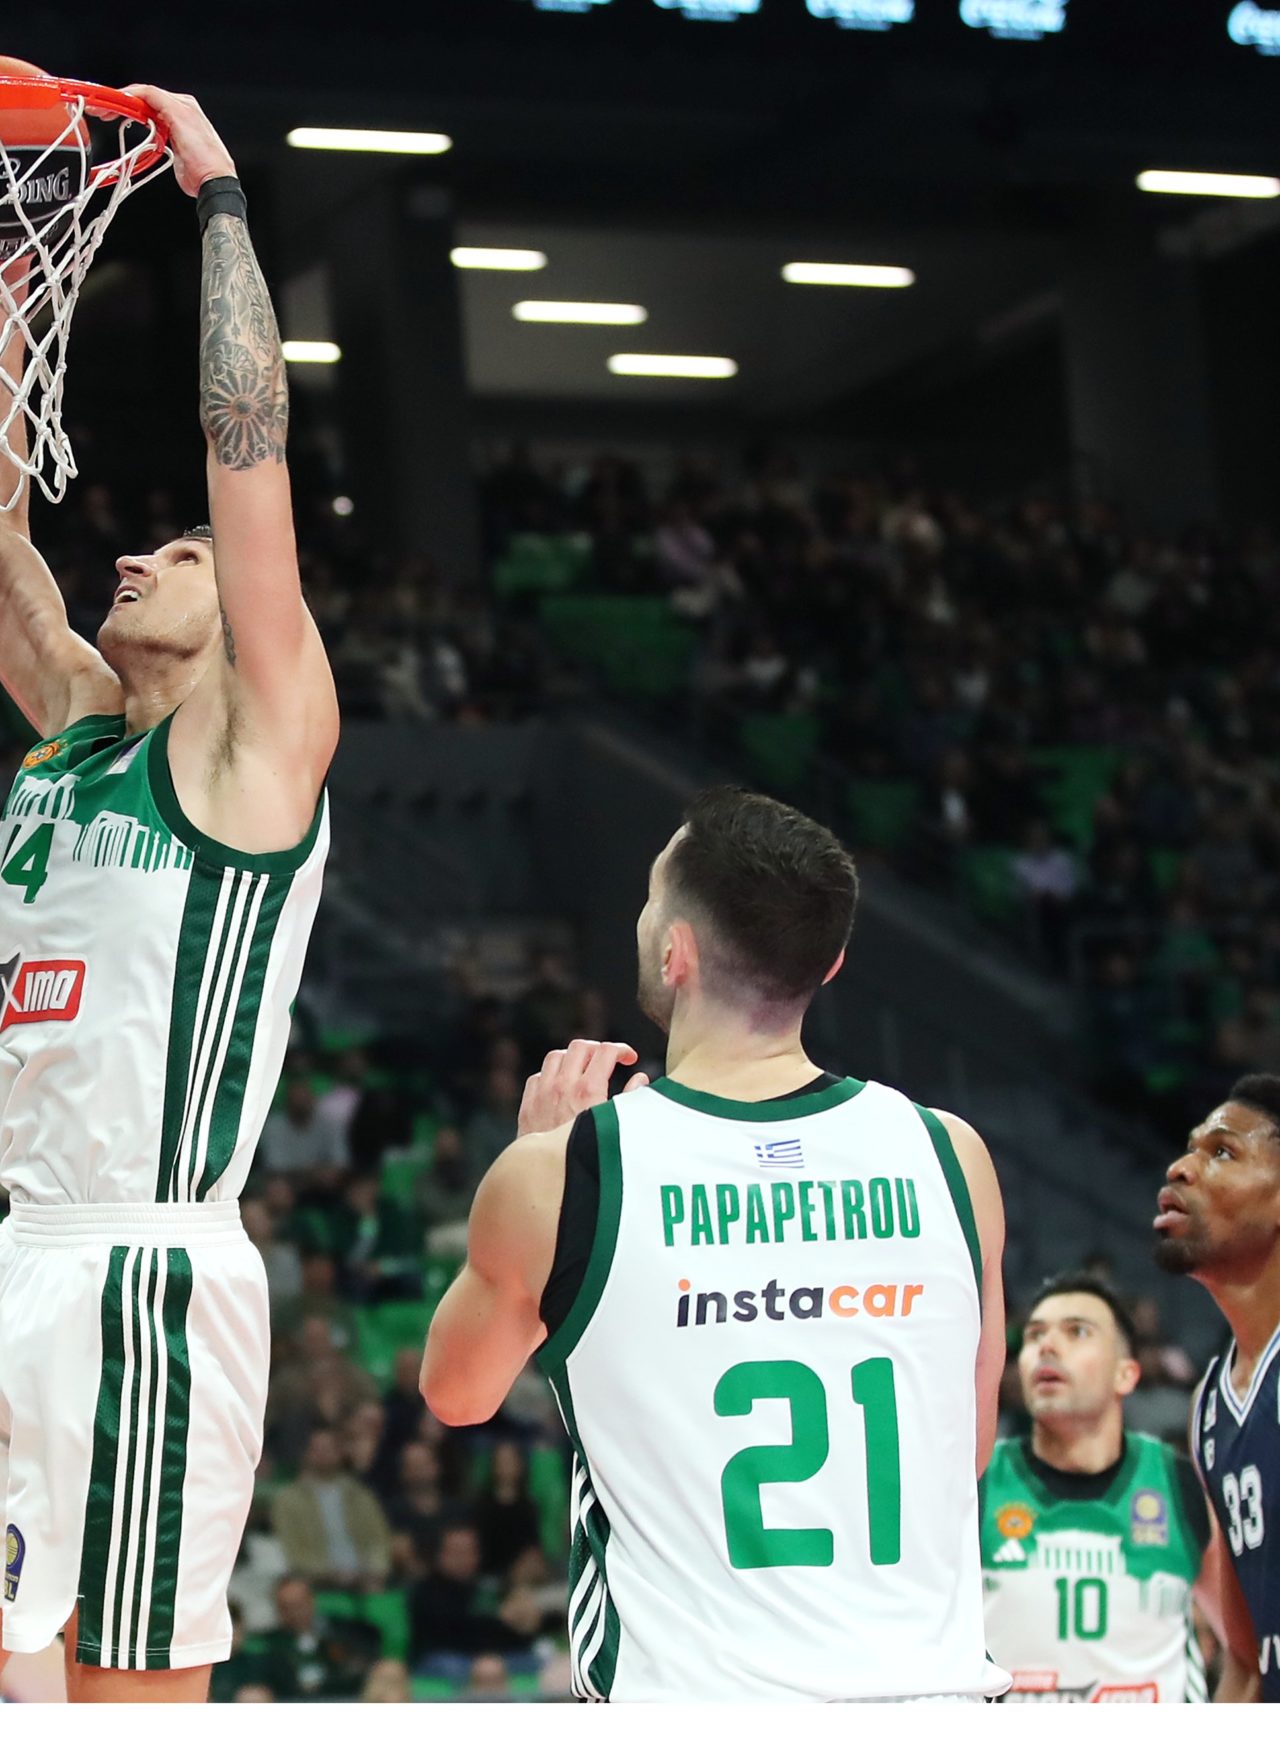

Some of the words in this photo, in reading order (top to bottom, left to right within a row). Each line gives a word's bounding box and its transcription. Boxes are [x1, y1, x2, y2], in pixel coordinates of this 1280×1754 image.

[660, 1177, 922, 1248] PAPAPETROU
[676, 1278, 924, 1328] instacar
[713, 1356, 902, 1569] 21
[1222, 1464, 1265, 1556] 33
[1055, 1576, 1109, 1641] 10
